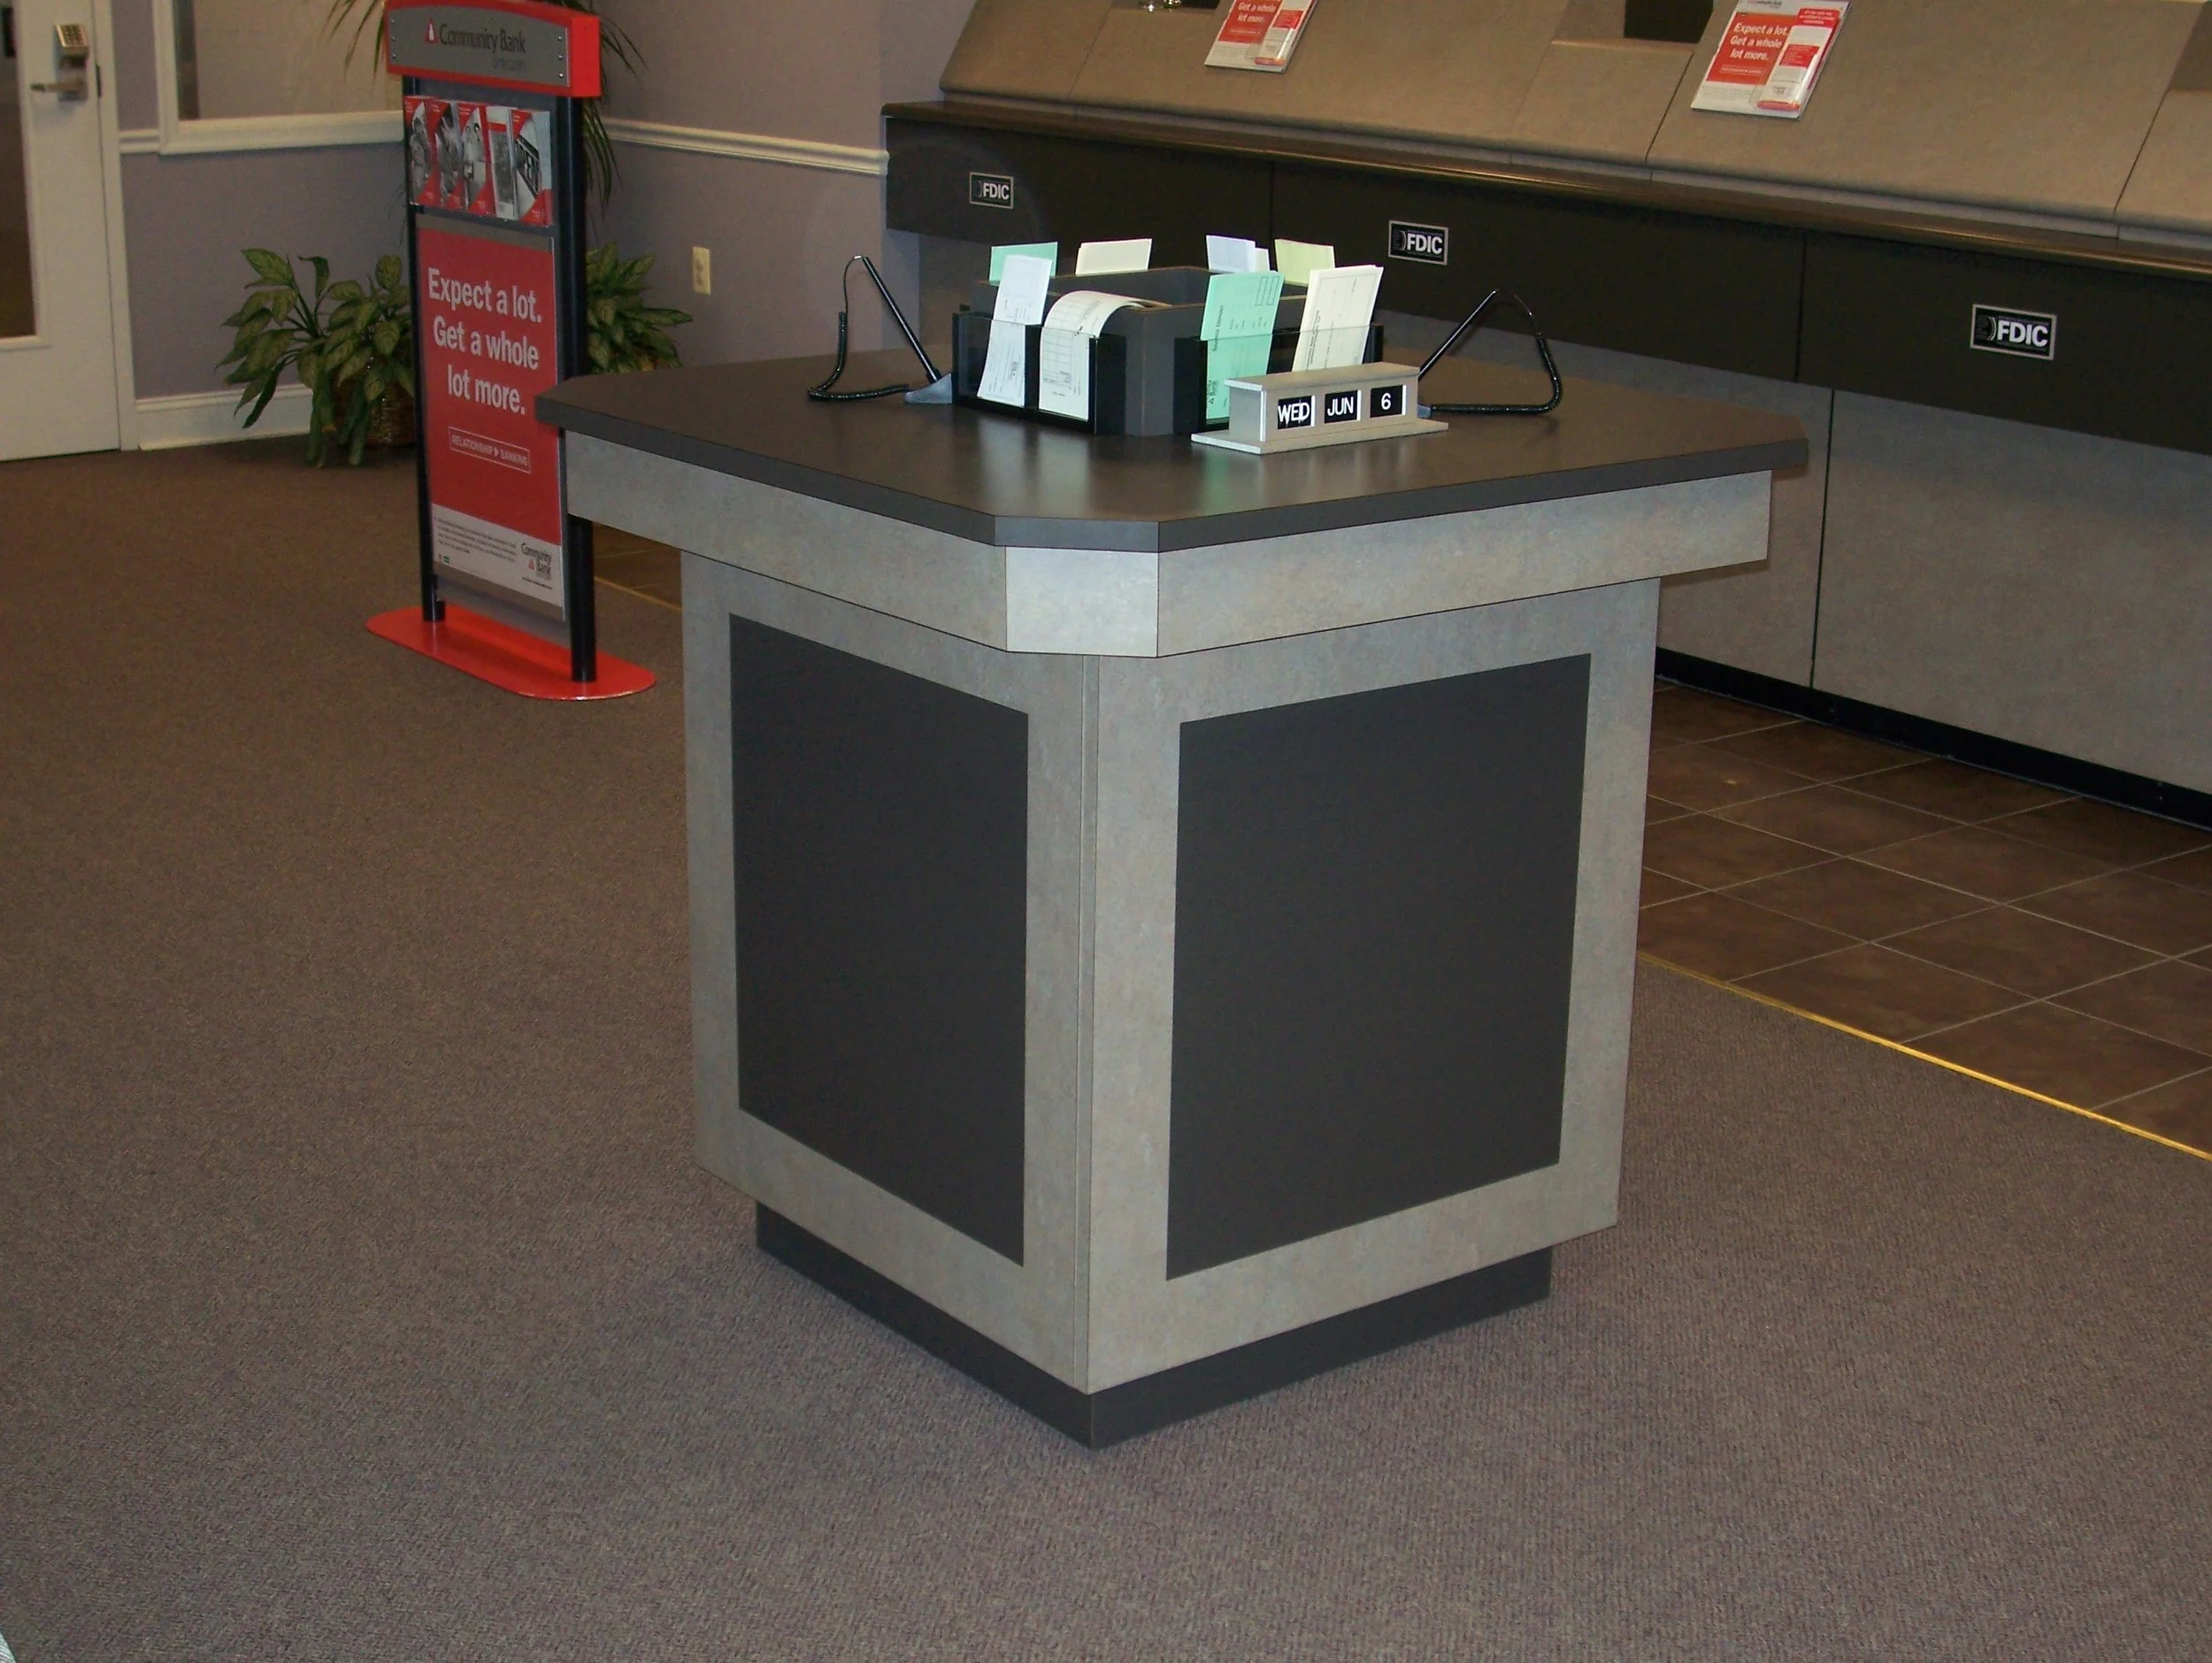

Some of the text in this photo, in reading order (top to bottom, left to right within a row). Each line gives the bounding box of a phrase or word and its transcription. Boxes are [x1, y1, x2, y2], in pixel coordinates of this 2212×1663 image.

[439, 23, 526, 55] Community Bank
[1734, 22, 1766, 35] Expect
[1730, 35, 1747, 46] Get
[1756, 38, 1783, 49] whole
[1730, 48, 1744, 59] lot
[983, 181, 1010, 200] FDIC
[1407, 233, 1443, 255] FDIC
[428, 267, 542, 323] Expect a lot.
[433, 315, 539, 370] Get a whole
[1997, 319, 2048, 348] FDIC
[448, 364, 526, 415] lot more.
[1327, 397, 1354, 417] JUN
[1381, 392, 1392, 411] 6
[1278, 402, 1310, 424] WED
[451, 435, 528, 467] RELATIONSHIP BANKING
